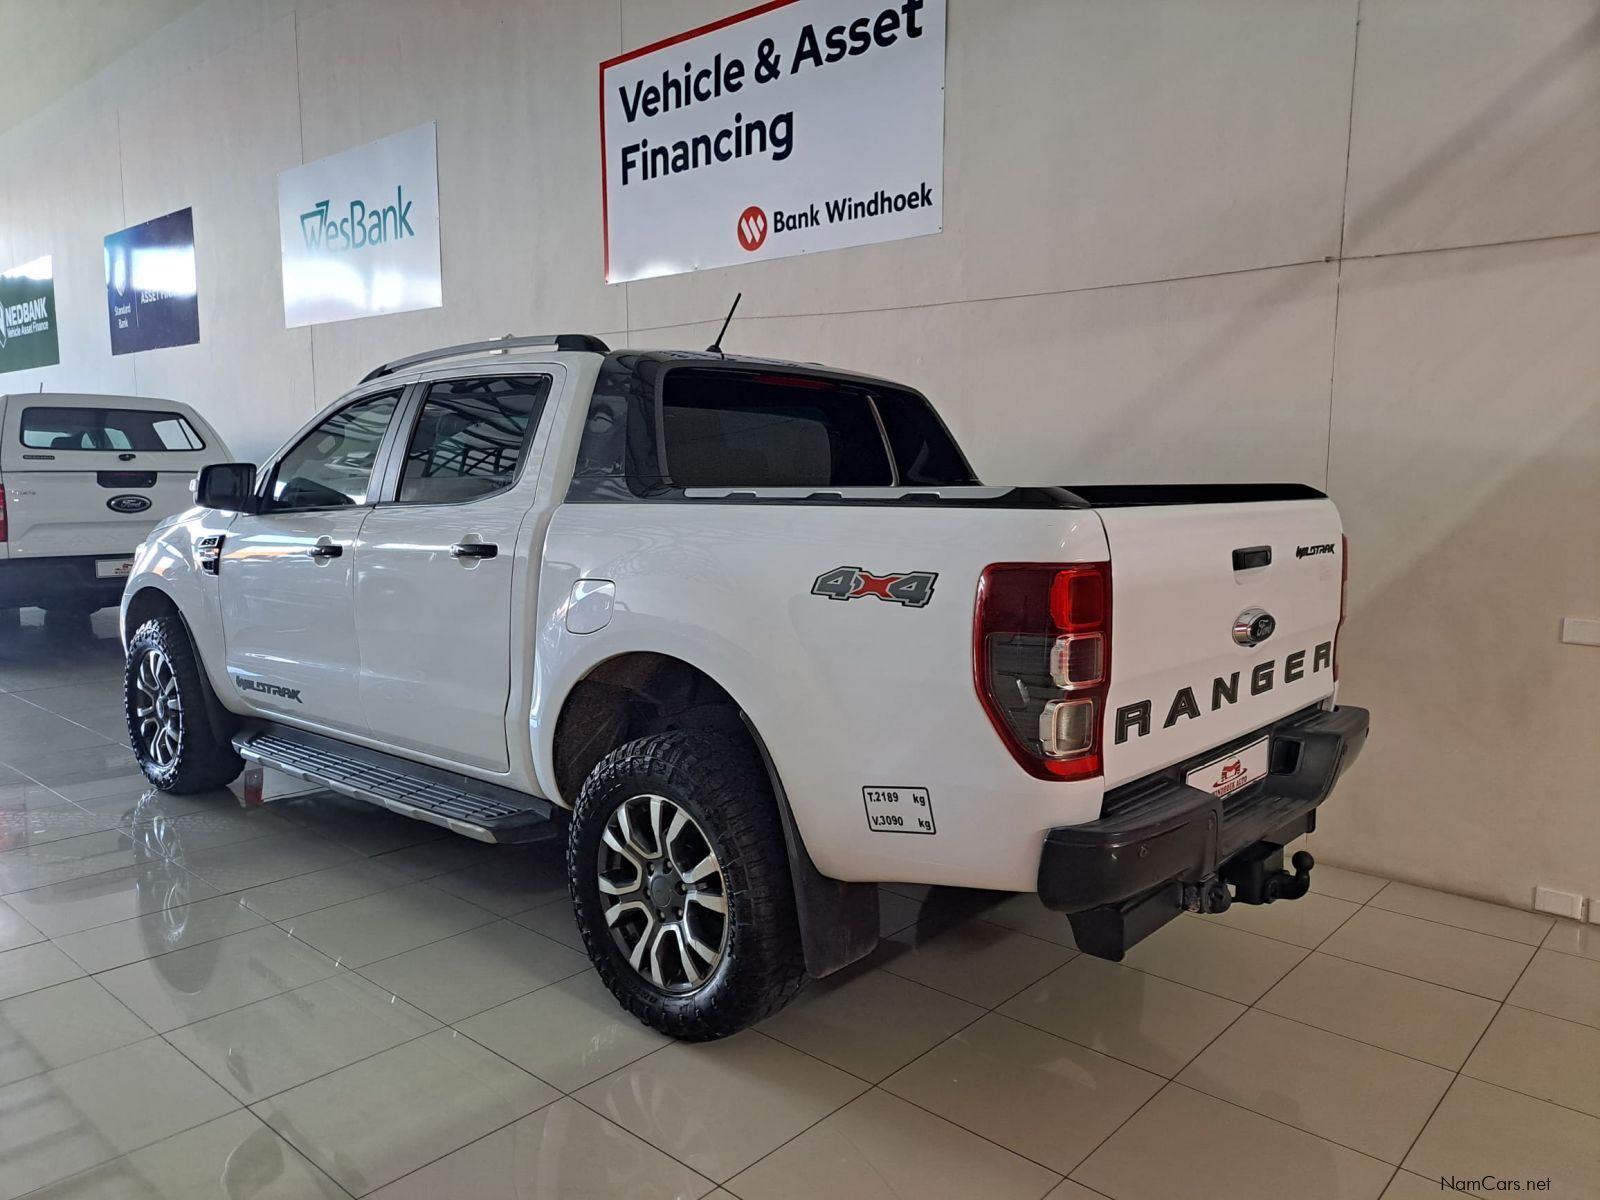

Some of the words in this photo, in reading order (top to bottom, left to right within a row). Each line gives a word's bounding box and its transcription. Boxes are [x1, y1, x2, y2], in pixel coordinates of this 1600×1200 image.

[619, 52, 745, 123] Vehicle
[754, 37, 781, 84] &
[790, 0, 924, 75] Asset
[621, 111, 793, 186] Financing
[300, 184, 415, 253] WesBank
[773, 204, 820, 233] Bank
[825, 182, 933, 223] Windhoek
[5, 296, 48, 327] NEDBANK
[1114, 641, 1332, 745] RANGER
[913, 793, 926, 807] kg
[918, 818, 931, 831] kg
